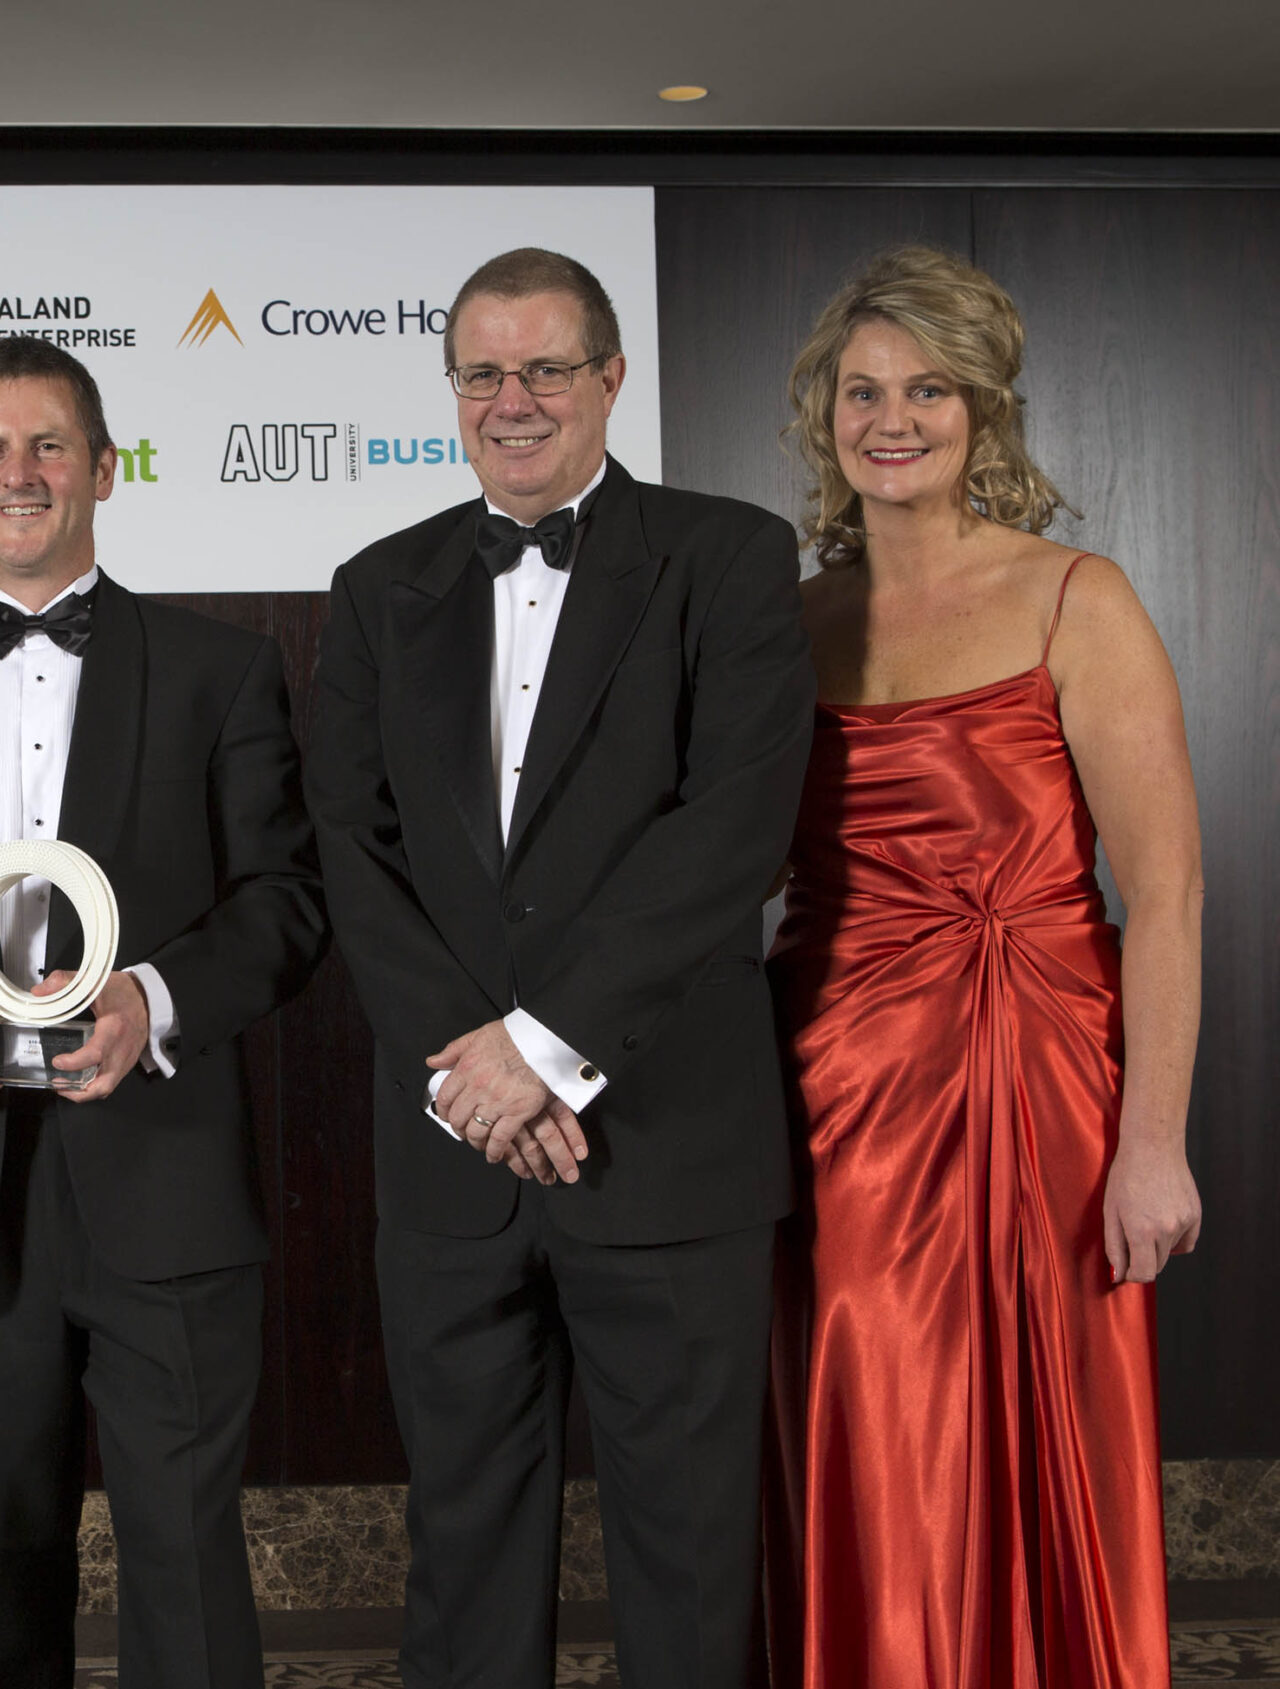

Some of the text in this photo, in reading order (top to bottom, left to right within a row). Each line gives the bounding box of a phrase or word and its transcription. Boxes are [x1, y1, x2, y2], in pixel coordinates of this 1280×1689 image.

[261, 299, 449, 335] Crowe Ho
[220, 423, 337, 482] AUT
[349, 422, 357, 482] UNIVERSITY
[367, 437, 473, 465] BUSI
